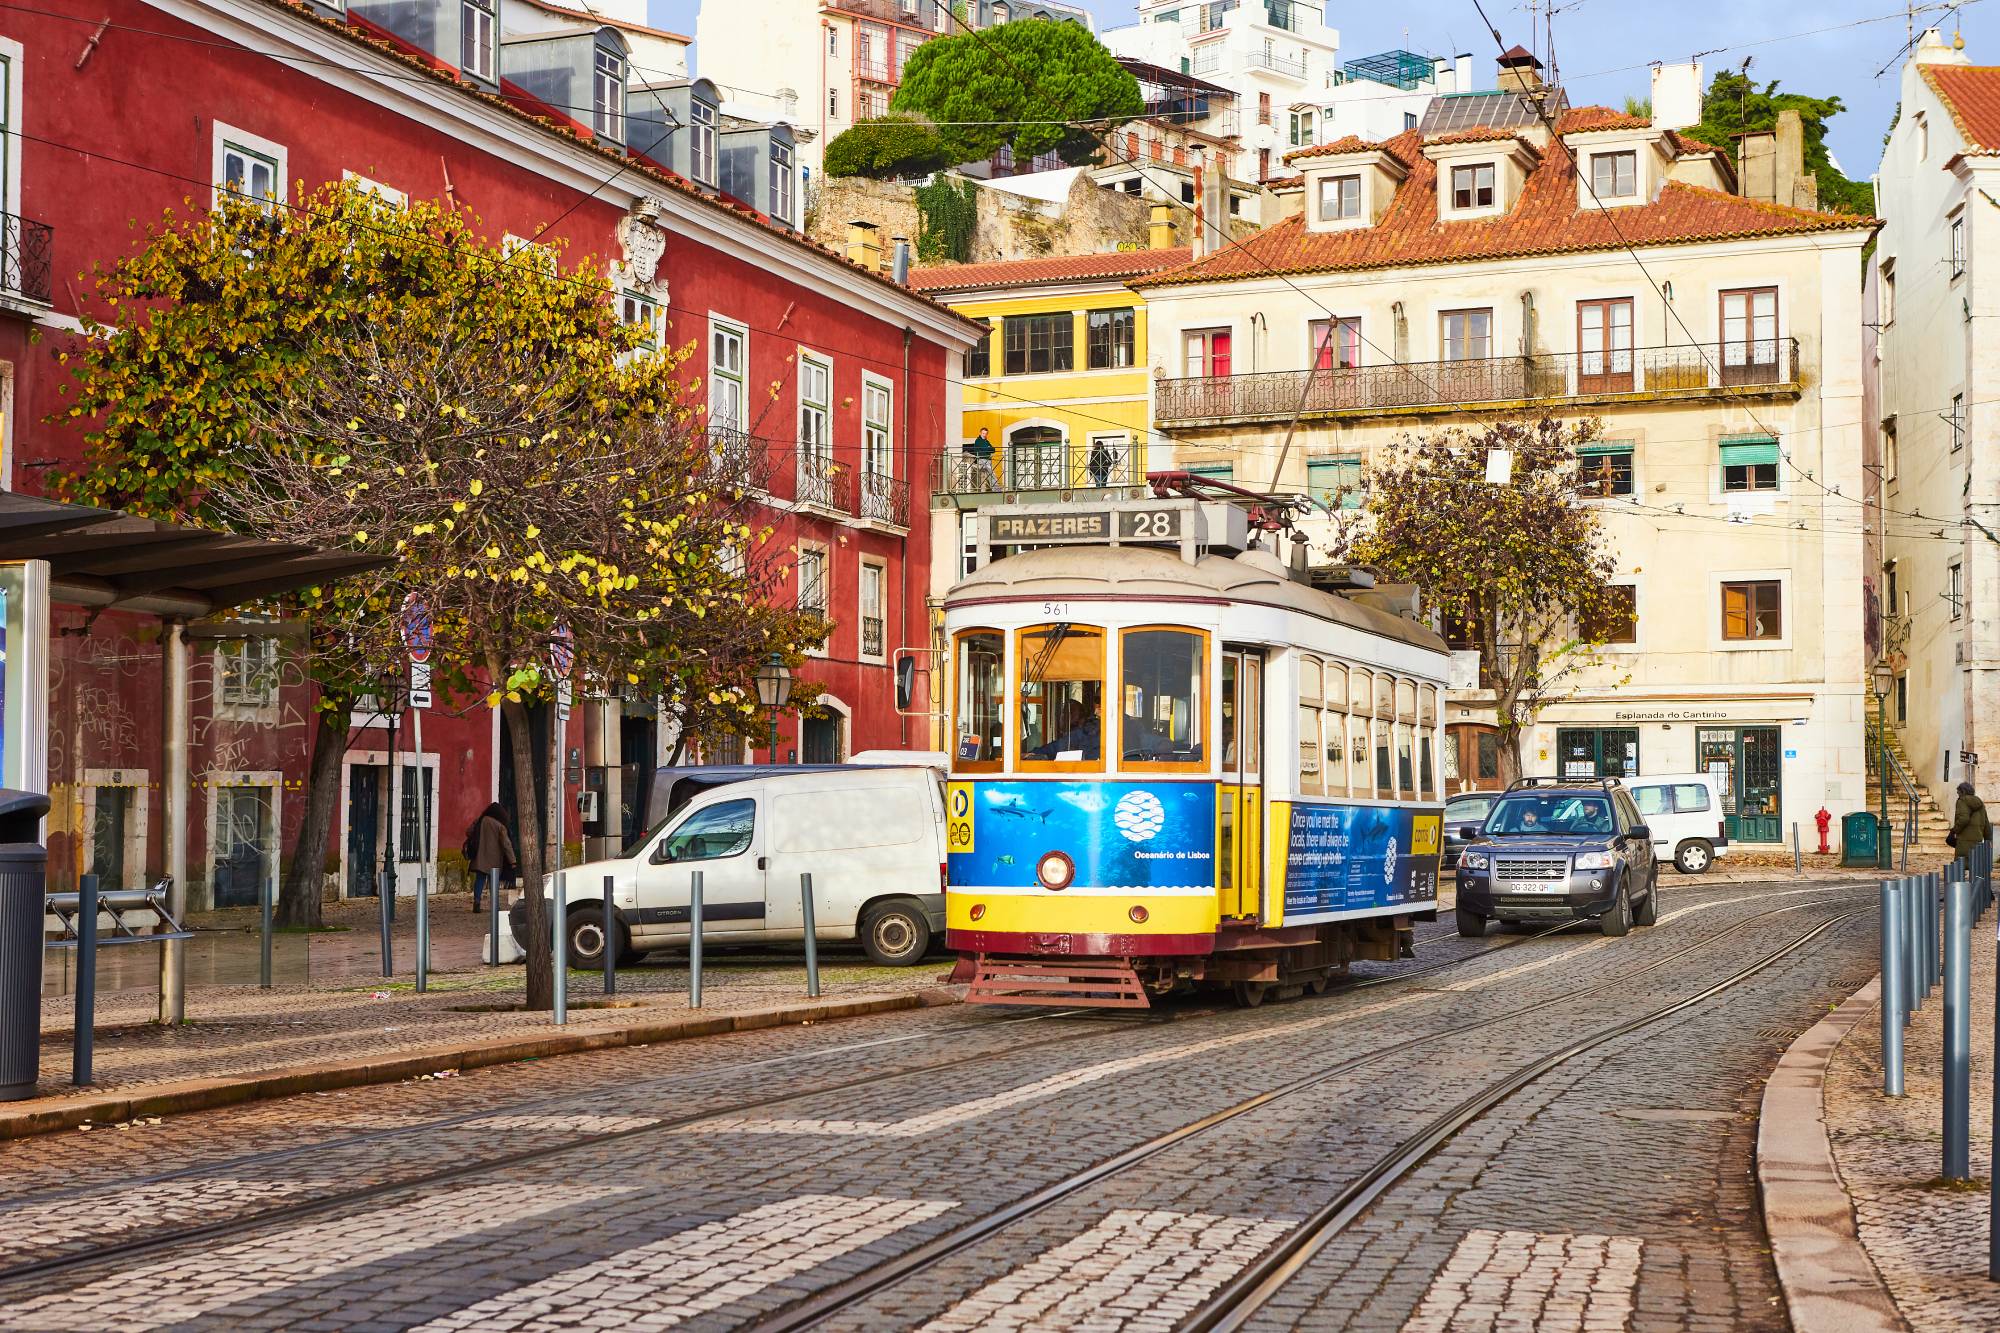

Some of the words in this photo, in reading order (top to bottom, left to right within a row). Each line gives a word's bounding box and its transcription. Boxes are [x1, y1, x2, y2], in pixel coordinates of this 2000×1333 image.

[997, 516, 1101, 537] PRAZERES
[1133, 512, 1170, 536] 28
[1043, 603, 1069, 616] 561
[1615, 711, 1664, 720] Esplanada
[1683, 711, 1727, 719] Cantinho
[960, 747, 968, 756] 03
[1134, 851, 1174, 859] Oceanário
[1176, 851, 1186, 859] de
[1187, 851, 1210, 859] Lisboa
